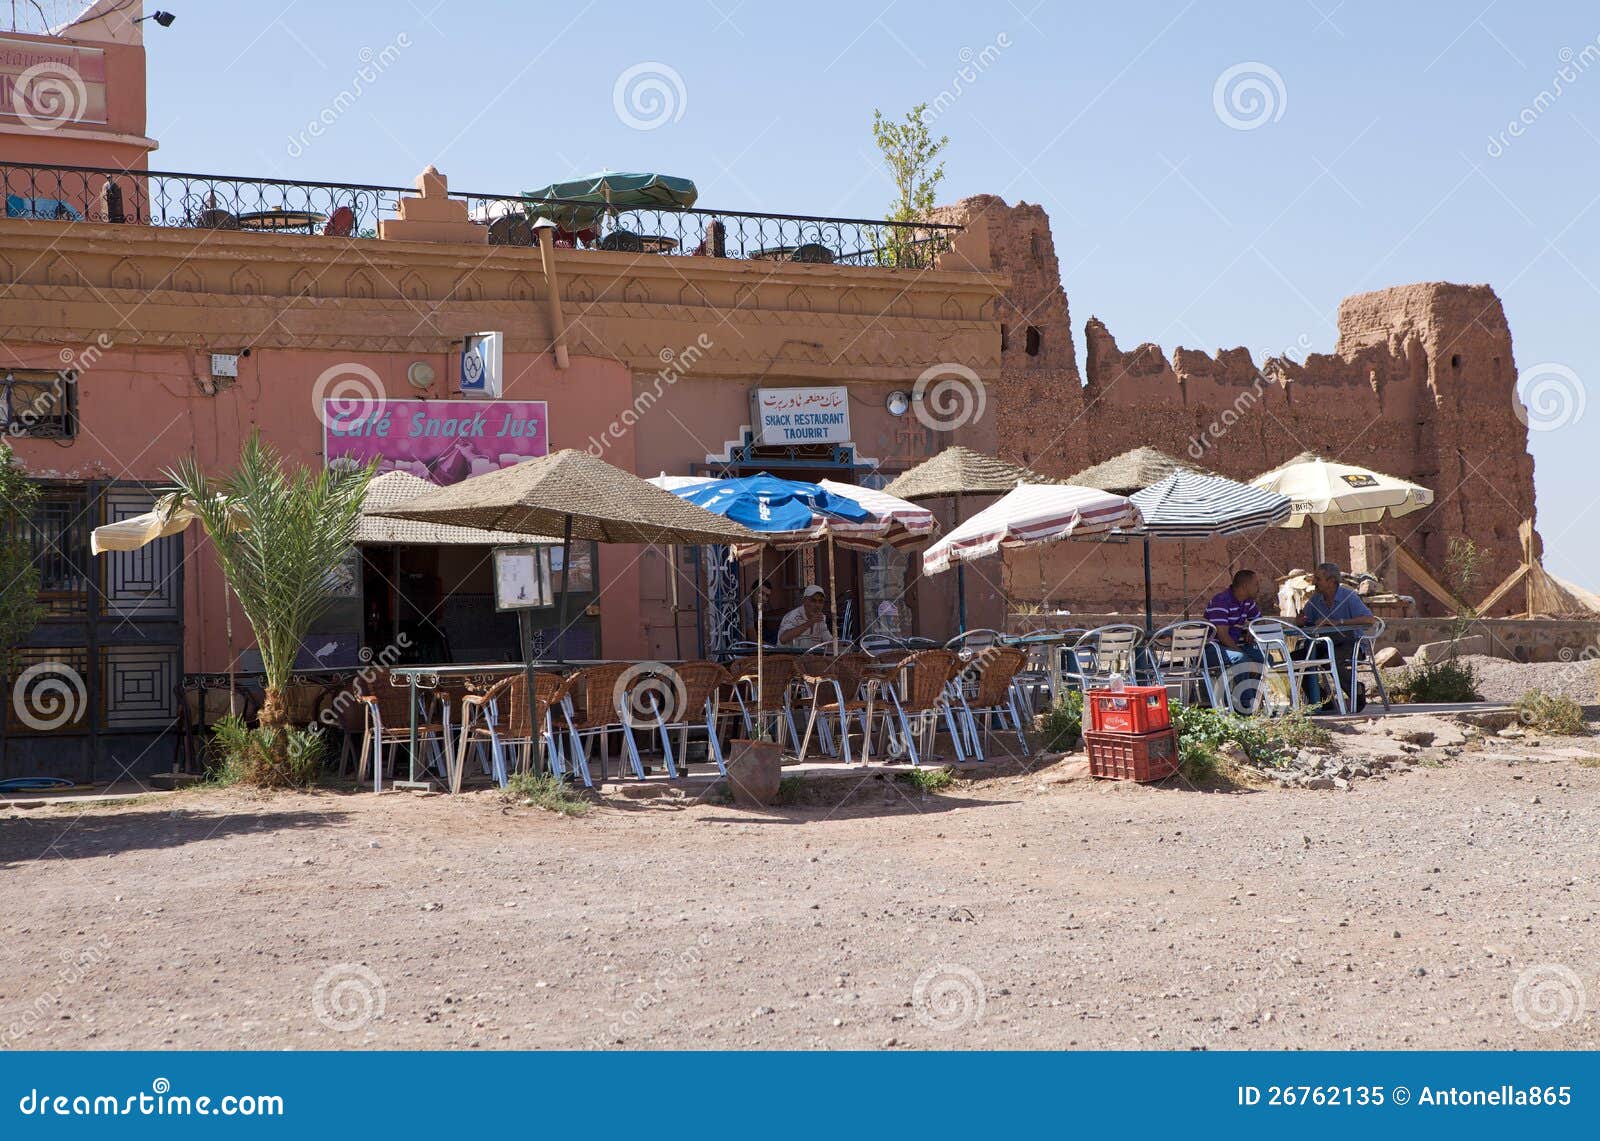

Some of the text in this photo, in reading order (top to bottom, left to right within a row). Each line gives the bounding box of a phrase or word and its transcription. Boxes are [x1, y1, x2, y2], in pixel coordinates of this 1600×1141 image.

[0, 50, 72, 71] staurant
[330, 410, 538, 438] Café Snack Jus
[765, 413, 845, 426] SNACK RESTAURANT
[784, 427, 828, 440] TAOURIRT
